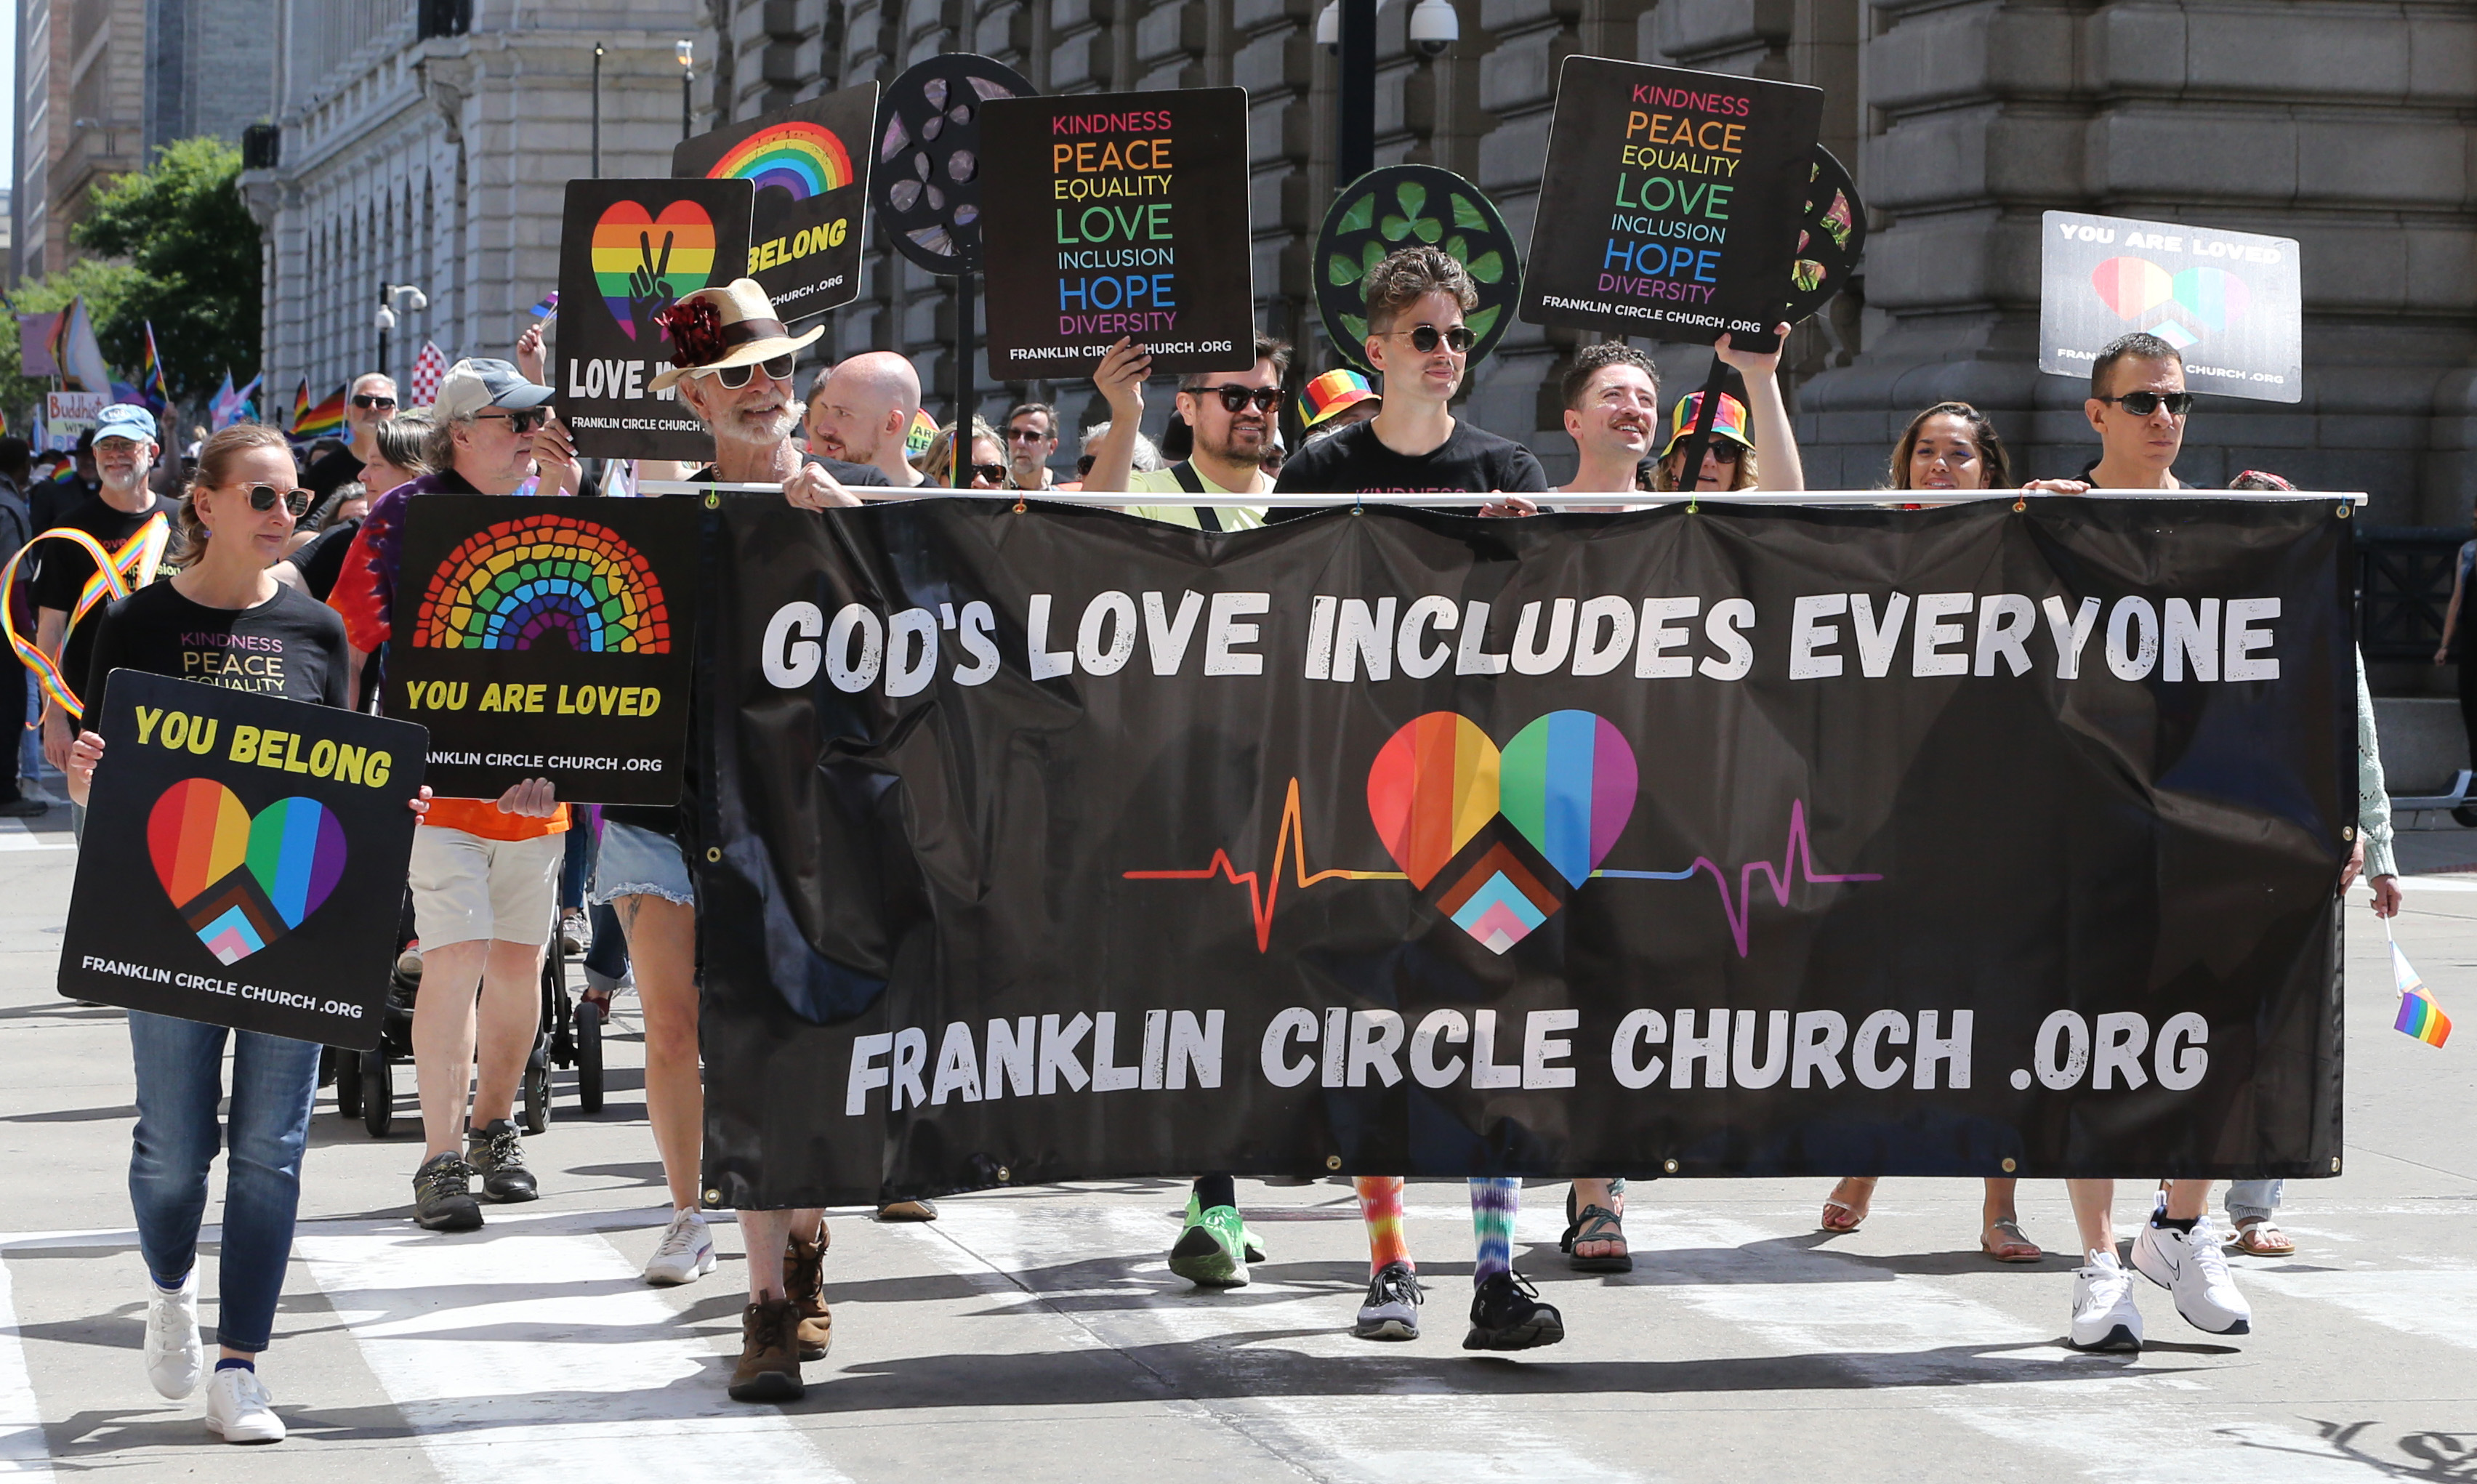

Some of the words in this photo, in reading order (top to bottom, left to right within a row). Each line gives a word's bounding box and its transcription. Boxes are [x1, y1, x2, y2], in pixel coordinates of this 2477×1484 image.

[1632, 84, 1749, 116] KINDNESS
[1053, 110, 1171, 134] KINDNESS
[1626, 110, 1746, 153] PEACE
[1054, 139, 1172, 173] PEACE
[1622, 145, 1740, 177] EQUALITY
[1055, 175, 1172, 202] EQUALITY
[1615, 172, 1733, 219] LOVE
[1058, 204, 1172, 243] LOVE
[1611, 214, 1725, 244] INCLUSION
[748, 218, 847, 275] BELONG
[1059, 248, 1173, 269] INCLUSION
[1603, 238, 1721, 283] HOPE
[2059, 224, 2114, 243] YOU
[2125, 232, 2183, 251] ARE
[2193, 239, 2281, 265] LOVED
[770, 284, 814, 306] CHURCH
[817, 275, 842, 291] .ORG
[1060, 274, 1175, 310] HOPE
[1598, 273, 1715, 305] DIVERSITY
[1060, 312, 1176, 334] DIVERSITY
[1543, 296, 1611, 313] FRANKLIN
[1615, 305, 1663, 320] CIRCLE
[1667, 312, 1724, 328] CHURCH
[1727, 320, 1760, 333] .ORG
[1010, 347, 1079, 360] FRANKLIN
[1141, 342, 1194, 355] HURCH
[1199, 341, 1231, 352] .ORG
[2058, 348, 2097, 360] FRAN
[2186, 364, 2246, 379] CHURCH
[2250, 373, 2284, 384] .ORG
[569, 359, 644, 399] LOVE
[572, 417, 619, 428] FRANKLIN
[622, 419, 656, 430] CIRCLE
[658, 420, 699, 431] CHURCH
[180, 632, 283, 653] KINDNESS
[762, 601, 1000, 697] GOD'S
[1028, 589, 1270, 681] LOVE
[1305, 595, 1755, 682] INCLUDES
[1789, 592, 2281, 682] EVERYONE
[183, 652, 284, 677] PEACE
[407, 681, 468, 710] YOU
[479, 683, 547, 712] ARE
[557, 685, 660, 717] LOVED
[136, 706, 218, 754] YOU
[229, 725, 391, 788] BELONG
[426, 751, 480, 765] ANKLIN
[486, 754, 543, 767] CIRCLE
[548, 757, 617, 770] CHURCH
[622, 759, 661, 771] .ORG
[83, 956, 171, 983] FRANKLIN
[175, 973, 237, 996] CIRCLE
[242, 985, 315, 1009] CHURCH
[320, 1001, 362, 1018] .ORG
[846, 1009, 1225, 1116] FRANKLIN
[1261, 1007, 1579, 1089] CIRCLE
[1611, 1009, 1973, 1089] CHURCH
[2010, 1009, 2208, 1090] .ORG
